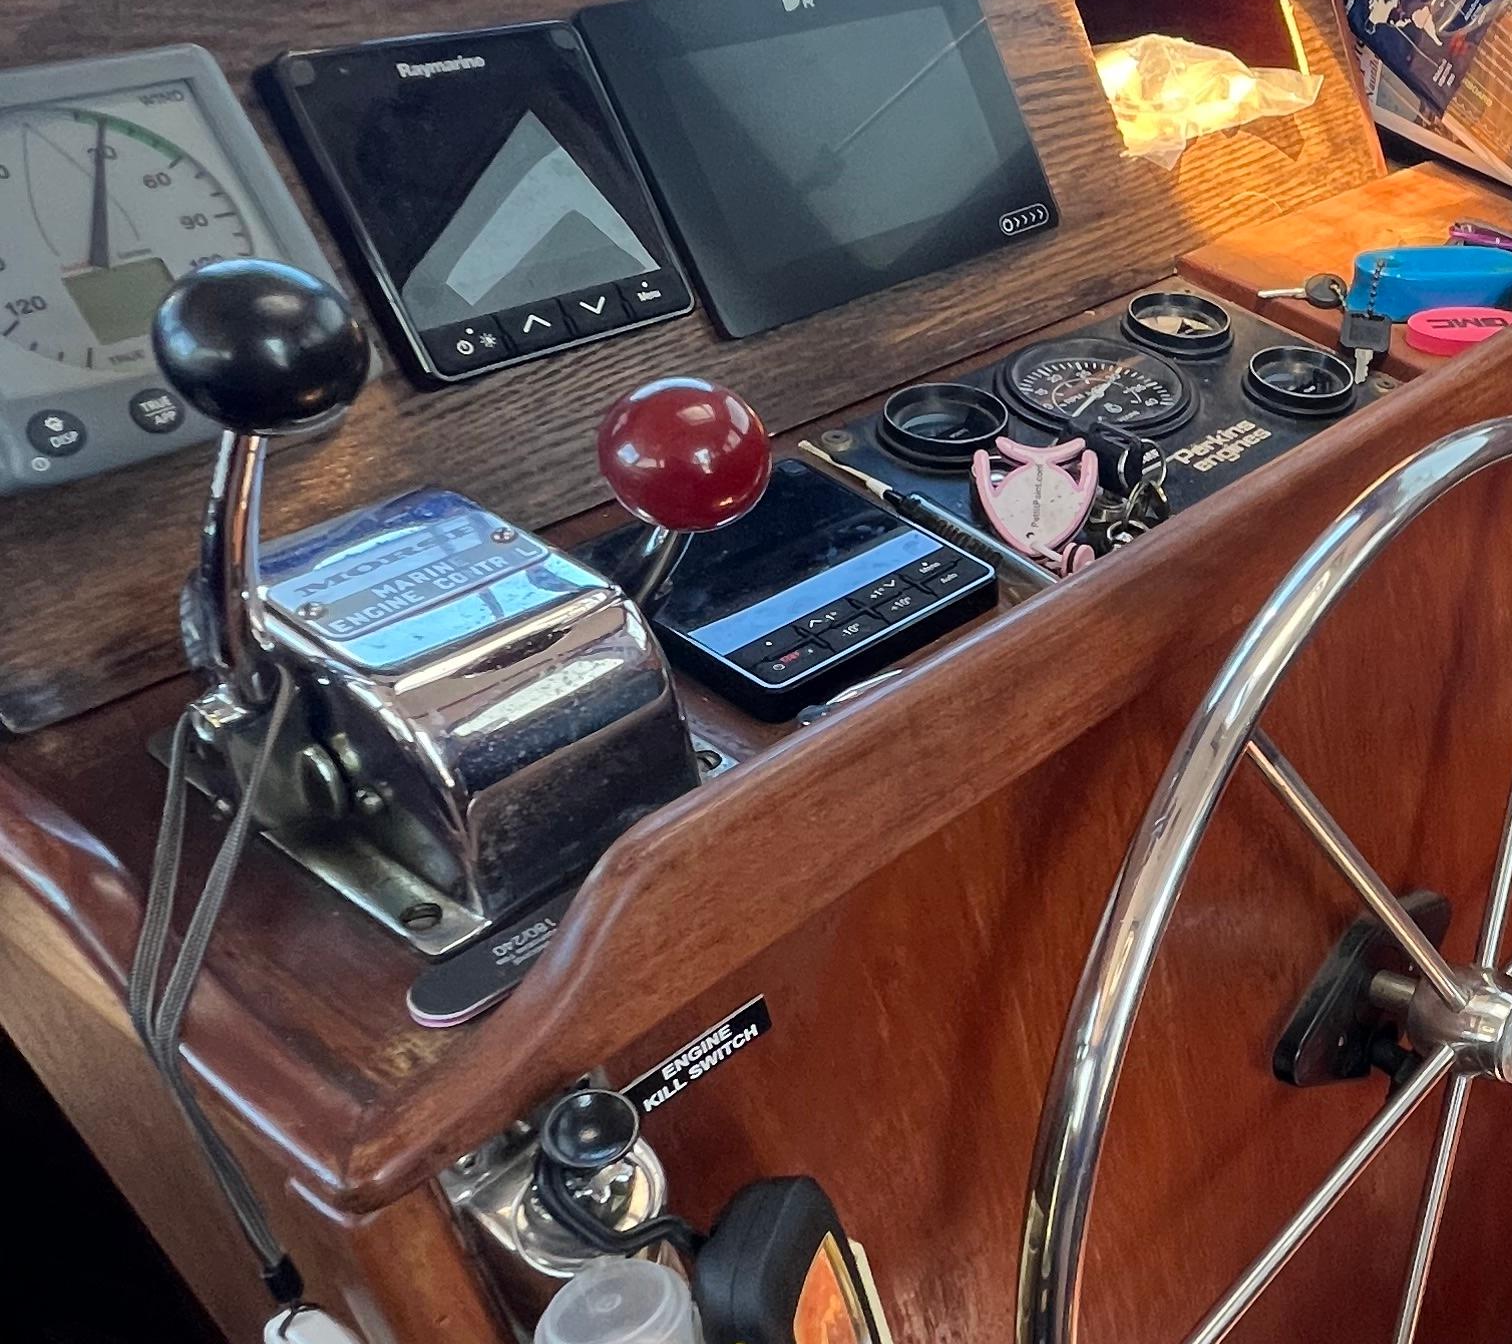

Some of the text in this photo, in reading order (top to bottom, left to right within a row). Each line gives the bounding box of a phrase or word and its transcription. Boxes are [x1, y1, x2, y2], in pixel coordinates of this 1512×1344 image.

[396, 55, 486, 78] Raymarine
[138, 88, 186, 107] WIND
[87, 144, 118, 161] 0
[142, 171, 172, 189] 60
[180, 213, 209, 230] 90
[5, 295, 47, 316] 120
[107, 348, 145, 364] TRUE
[139, 394, 173, 413] TRUE
[153, 409, 177, 427] APP
[1173, 419, 1256, 465] Perkins
[1192, 427, 1272, 472] engines
[293, 522, 476, 597] MORSE
[940, 572, 959, 584] Auto
[329, 592, 425, 633] ENGINE
[661, 1023, 733, 1081] ENGINE
[643, 1023, 759, 1113] KILL SWITCH
